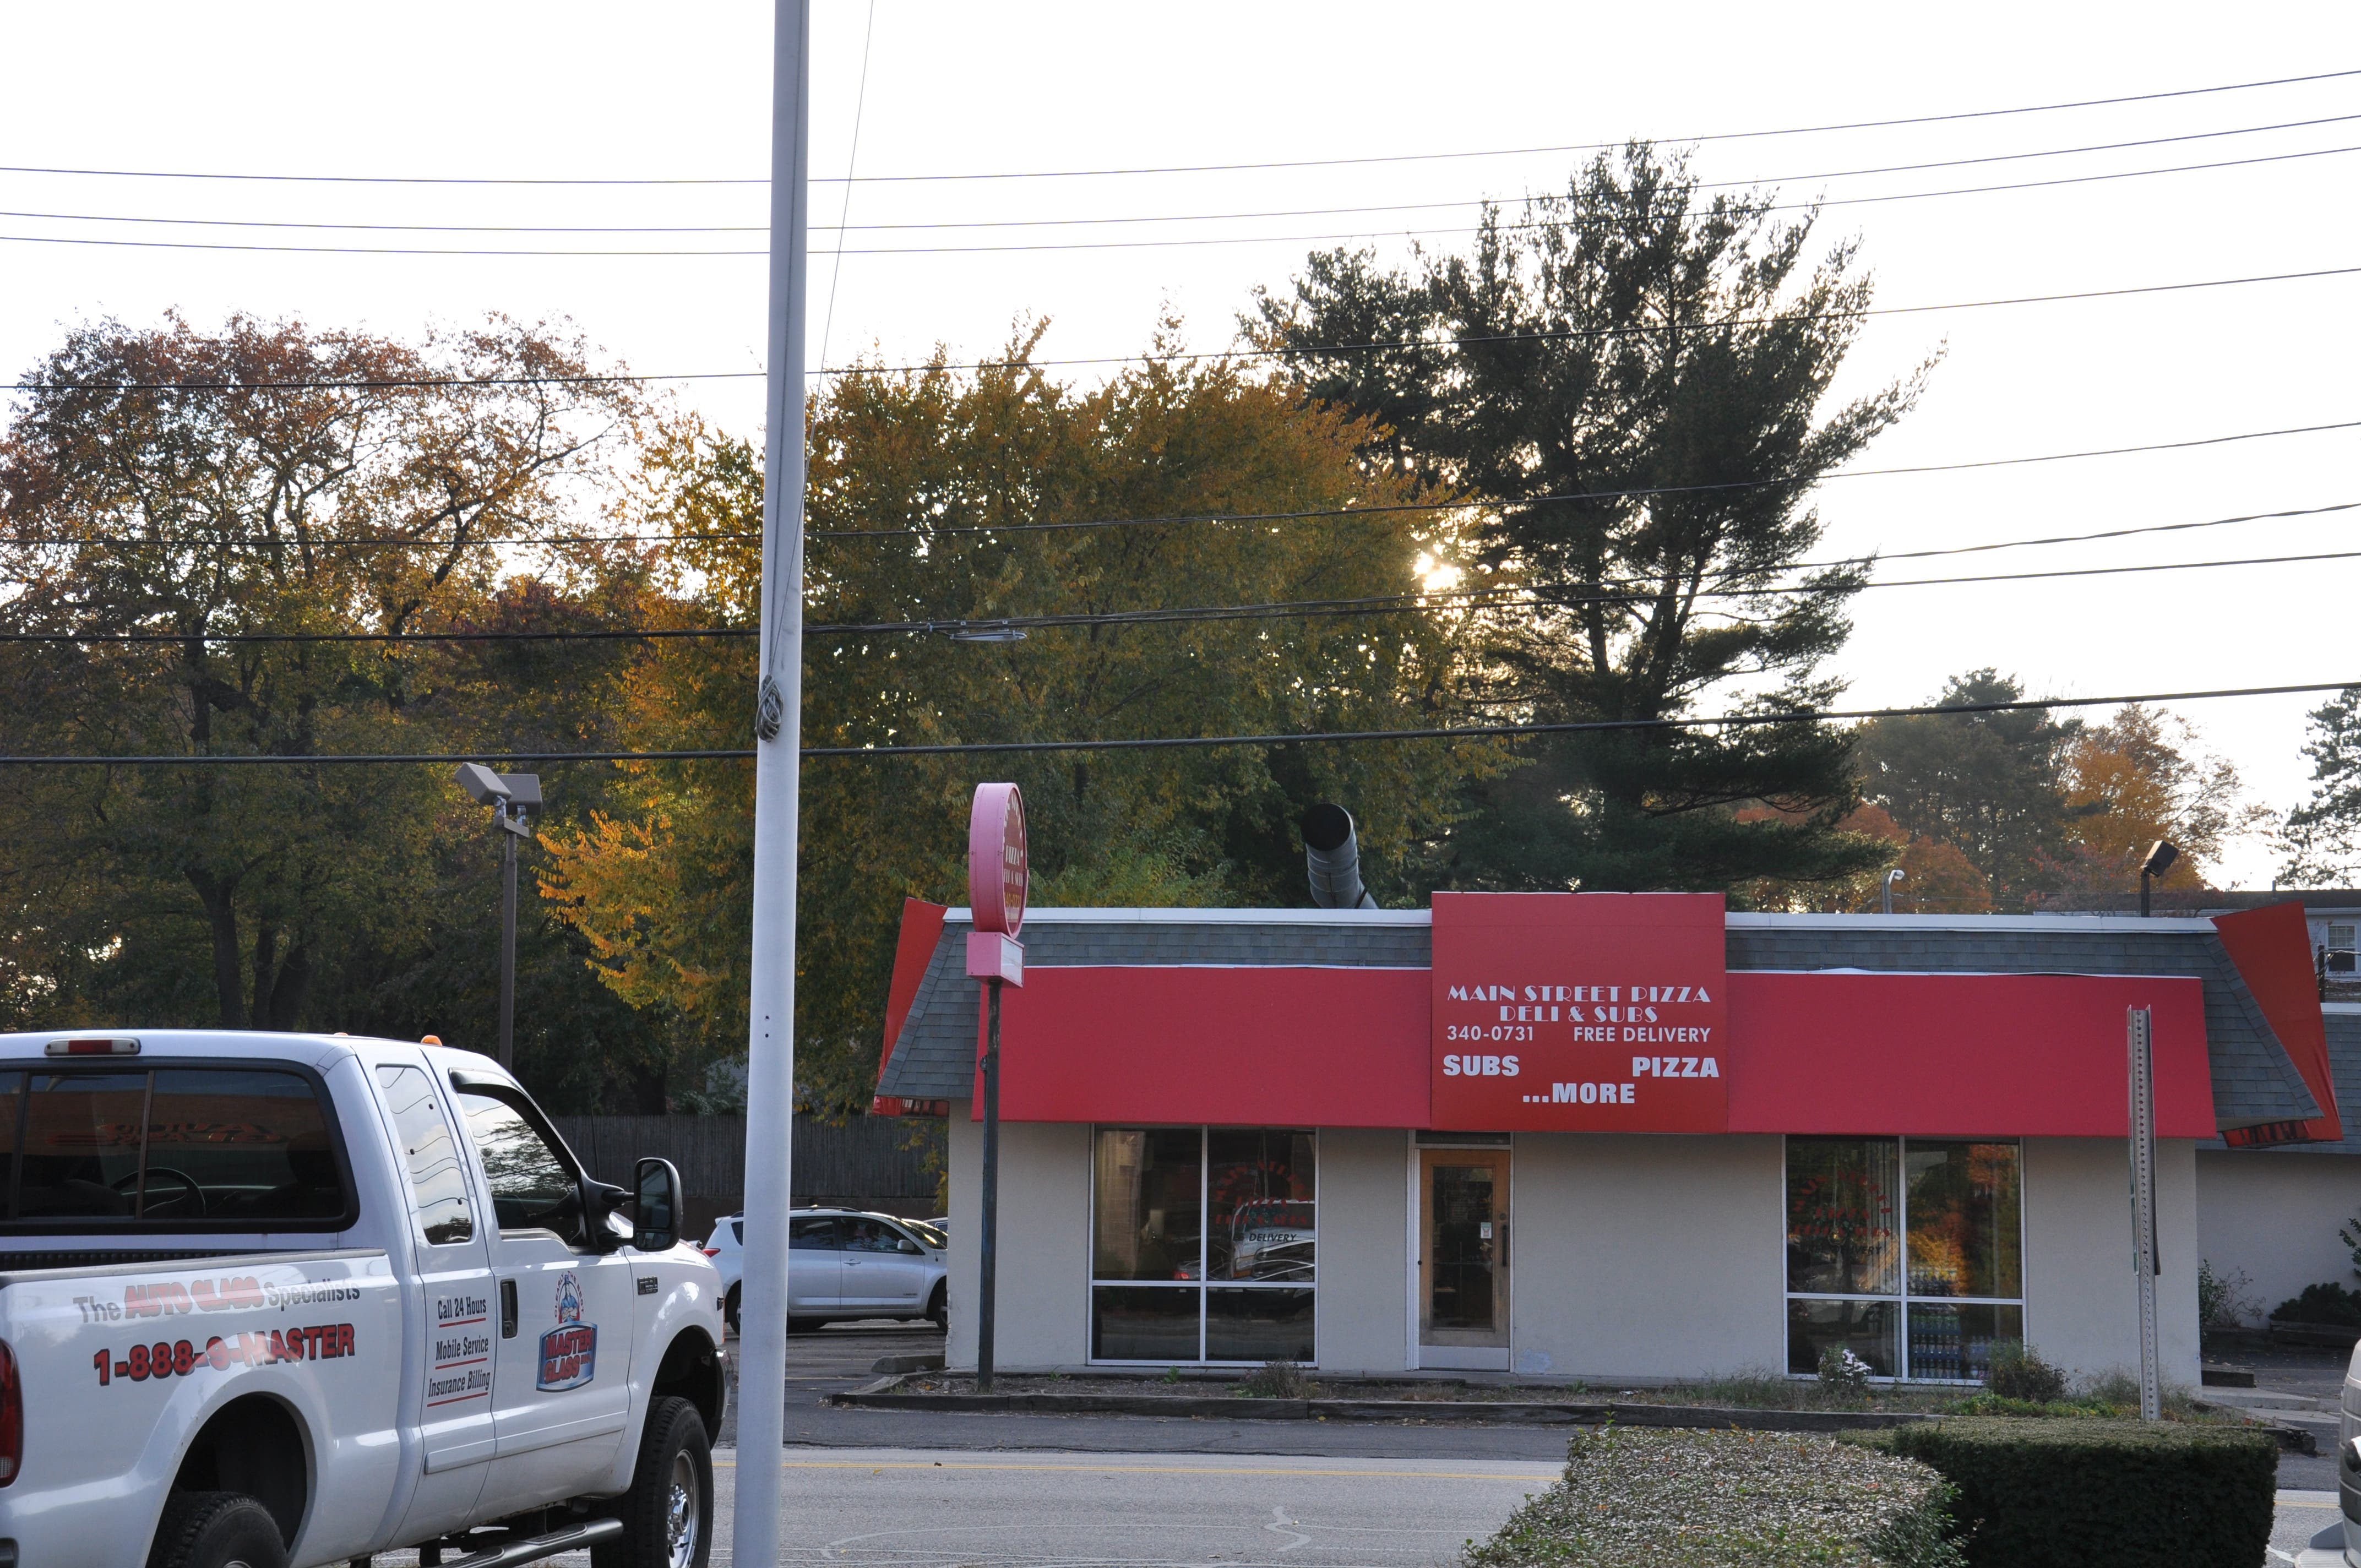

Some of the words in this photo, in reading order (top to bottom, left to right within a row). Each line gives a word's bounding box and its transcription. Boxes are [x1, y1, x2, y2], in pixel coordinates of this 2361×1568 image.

[1447, 984, 1515, 1001] MAIN
[1524, 985, 1622, 1002] STREET
[1630, 986, 1711, 1003] PIZZA
[1500, 1005, 1559, 1022] DELI
[1568, 1006, 1585, 1022] &
[1594, 1006, 1658, 1023] SUBS
[1446, 1025, 1534, 1041] 340-0731
[1573, 1026, 1616, 1042] FREE
[1623, 1027, 1711, 1043] DELIVERY
[1443, 1055, 1520, 1076] SUBS
[1632, 1057, 1720, 1078] PIZZA
[1522, 1082, 1635, 1104] ...MORE
[1249, 1233, 1297, 1243] DELIVERY
[72, 1296, 121, 1323] The
[124, 1282, 193, 1319] AUTO
[191, 1276, 265, 1312] GLASS
[264, 1278, 361, 1311] Specialists
[437, 1299, 453, 1320] Call
[454, 1297, 465, 1317] 24
[466, 1297, 487, 1316] Hours
[94, 1322, 356, 1386] 1-888-9-MASTER
[436, 1338, 461, 1361] Mobile
[463, 1335, 489, 1355] Service
[546, 1327, 593, 1360] MASTER
[544, 1354, 580, 1385] GLASS
[428, 1375, 466, 1398] Insurance
[467, 1369, 491, 1391] Billing
